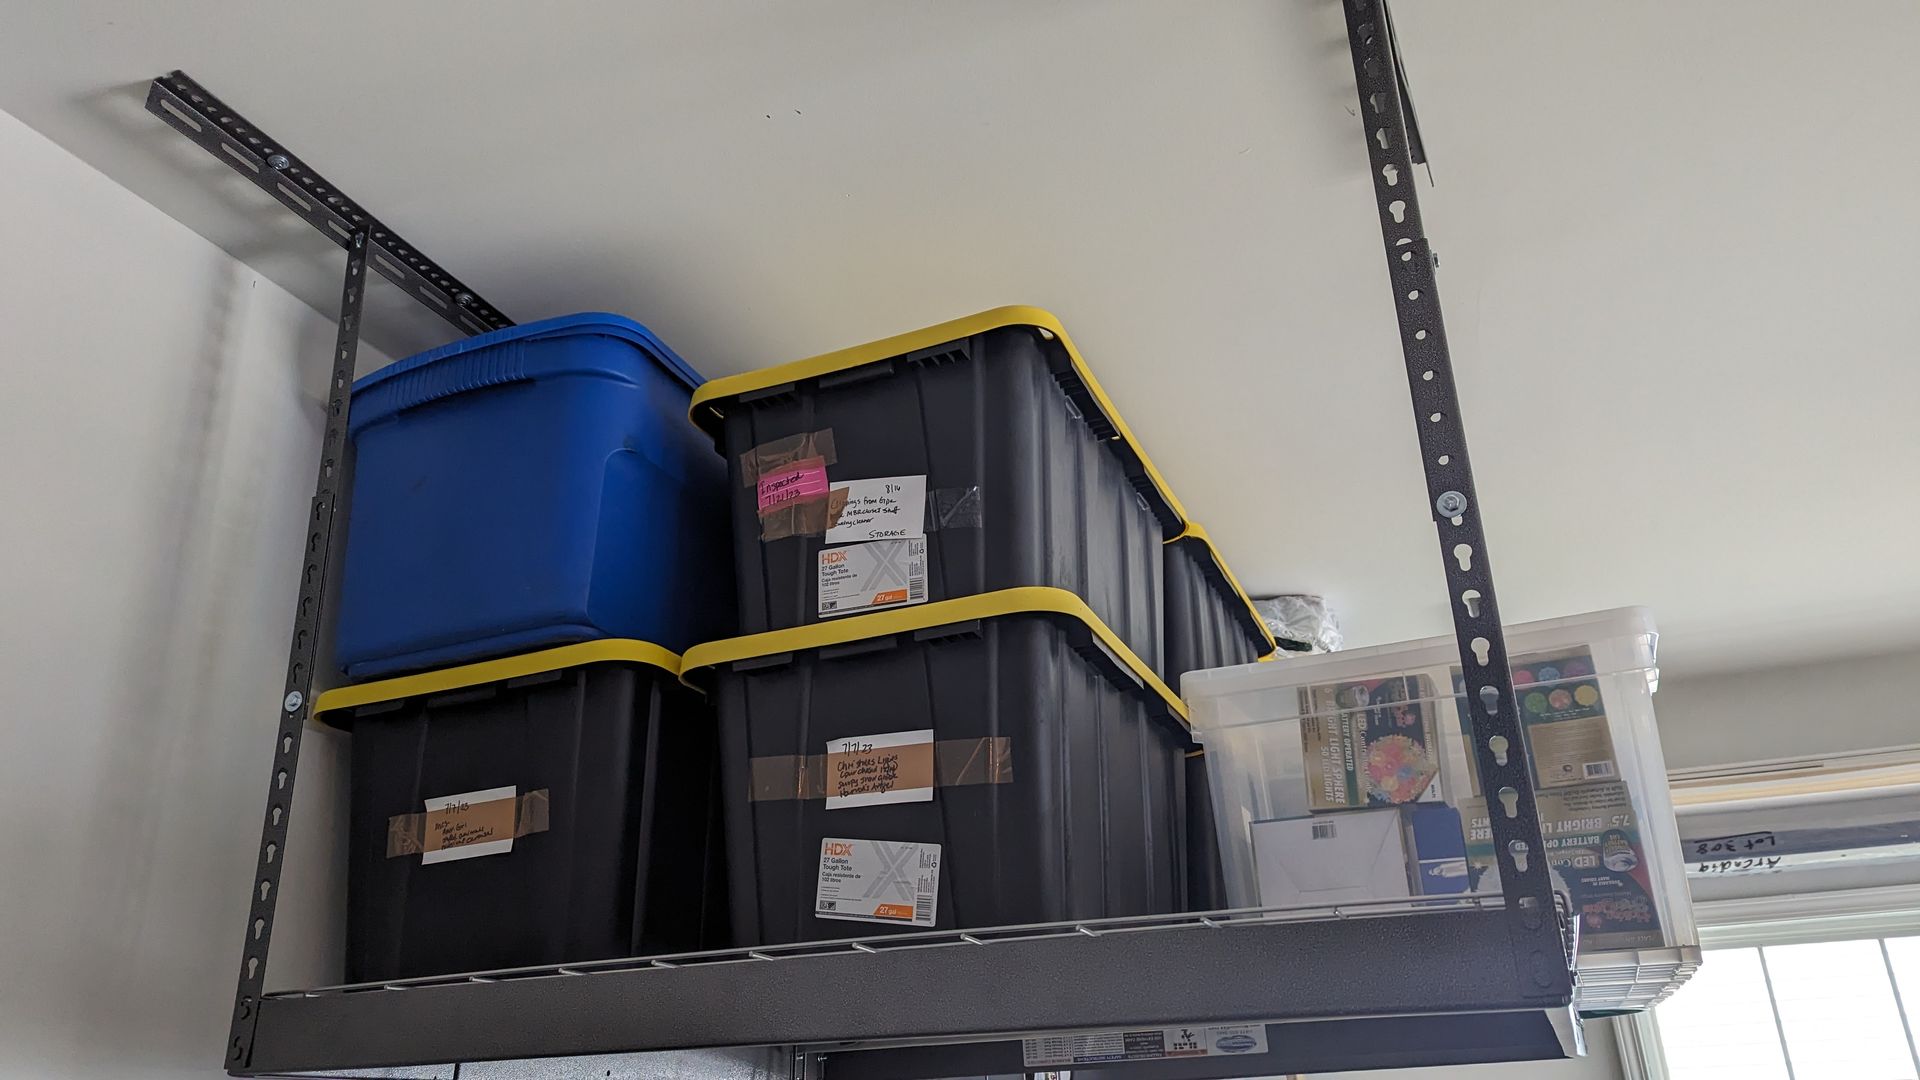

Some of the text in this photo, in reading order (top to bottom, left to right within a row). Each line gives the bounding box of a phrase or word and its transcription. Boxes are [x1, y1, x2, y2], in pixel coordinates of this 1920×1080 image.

[868, 528, 907, 539] STORAGE
[821, 551, 848, 565] HDX
[821, 570, 838, 578] Tough
[829, 563, 845, 571] Gallon
[877, 594, 885, 602] 27
[1357, 713, 1367, 728] LED
[1330, 738, 1341, 764] LIGHT
[1343, 738, 1354, 771] OPERATED
[1324, 774, 1334, 801] LIGHTS
[1332, 767, 1345, 804] SPHERE
[1556, 818, 1602, 832] BRIGHT
[1561, 836, 1599, 847] BATTERY
[1743, 834, 1776, 850] Lot
[824, 842, 853, 857] HDX
[823, 863, 840, 872] Tough
[830, 857, 848, 865] Gallon
[1574, 856, 1596, 867] LED
[1698, 855, 1782, 873] Arcadia
[879, 906, 888, 914] 27
